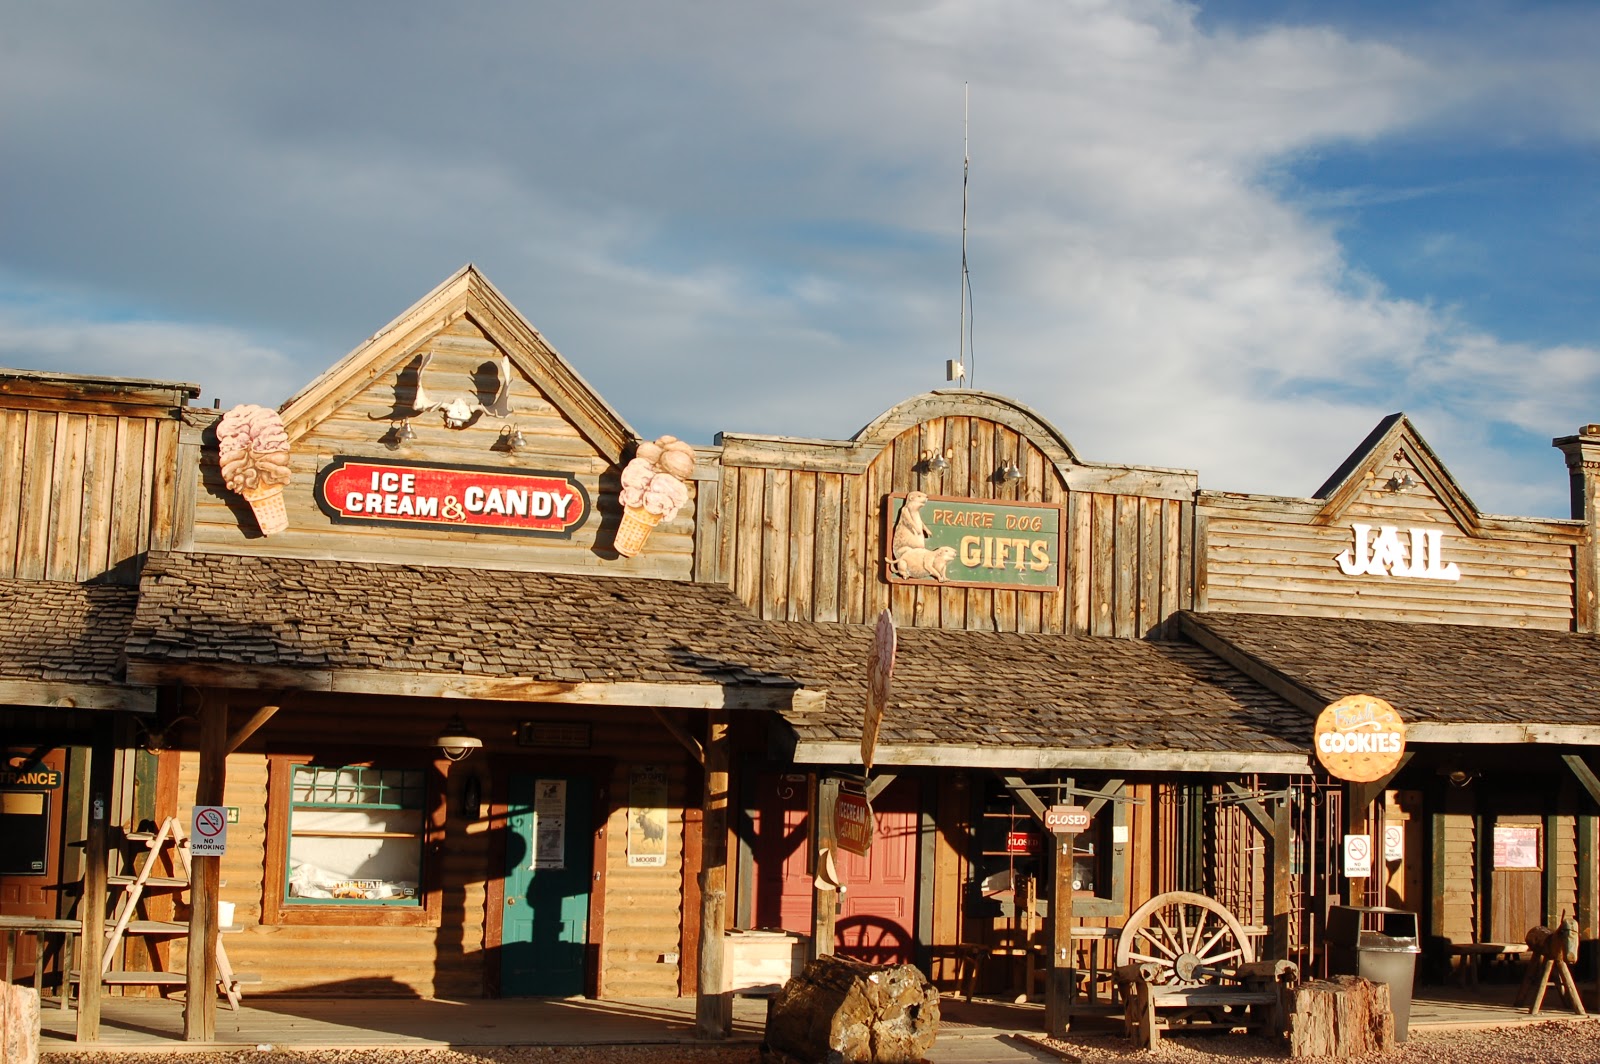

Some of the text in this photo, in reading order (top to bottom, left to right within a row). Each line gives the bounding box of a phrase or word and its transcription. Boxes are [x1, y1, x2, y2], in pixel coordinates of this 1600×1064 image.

[371, 471, 416, 494] ICE
[345, 486, 574, 520] CREAM & CANDY
[933, 509, 1042, 532] PRAIRE DOG
[960, 535, 1050, 572] GIFTS
[1334, 523, 1460, 580] JAIL
[1319, 732, 1401, 753] COOKIES
[1047, 814, 1087, 826] CLOSED
